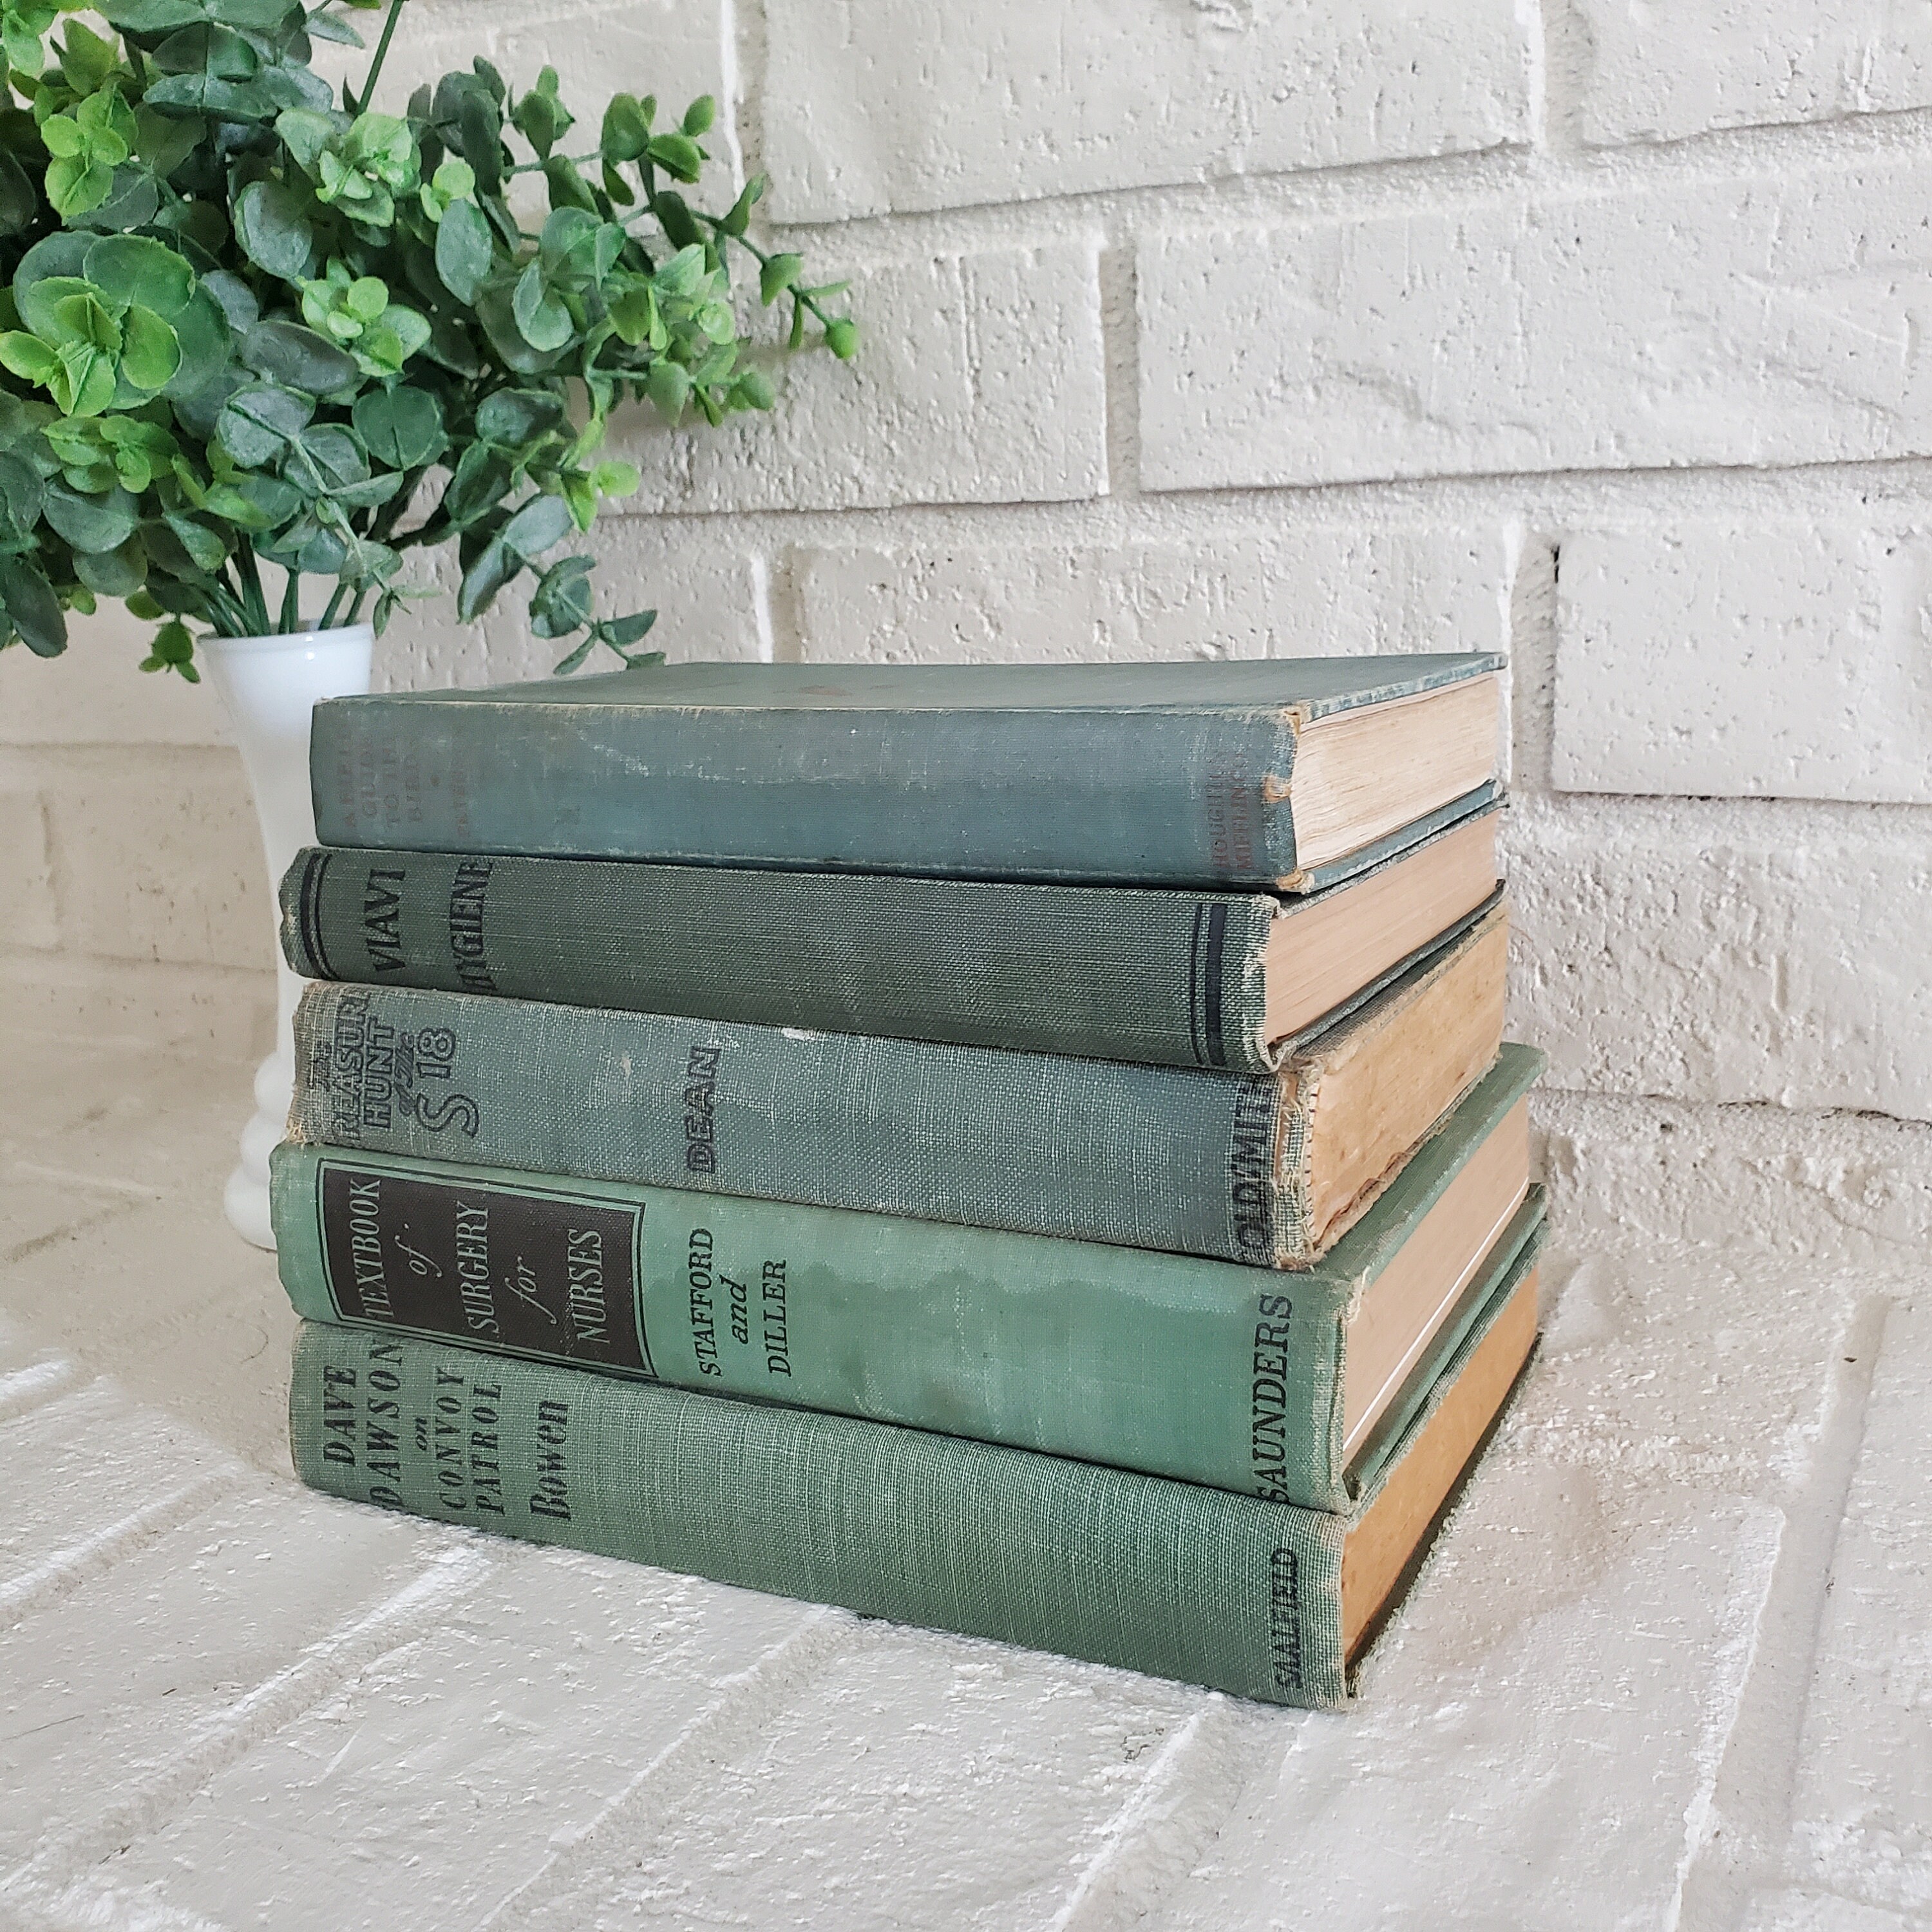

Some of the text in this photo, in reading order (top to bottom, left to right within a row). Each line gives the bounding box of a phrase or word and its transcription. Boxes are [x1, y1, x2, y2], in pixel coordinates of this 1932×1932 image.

[364, 869, 406, 972] VIAVI
[332, 993, 372, 1142] REASUR
[363, 1015, 395, 1129] HUNT
[415, 1028, 456, 1080] 18
[686, 1045, 721, 1174] DEAN
[349, 1179, 394, 1320] TEXTBOOK
[456, 1200, 500, 1334] SURGERY
[504, 1255, 558, 1325] for
[567, 1227, 611, 1345] NURSES
[689, 1227, 723, 1378] STAFFORD
[718, 1273, 749, 1345] and
[759, 1258, 793, 1379] DILLER
[323, 1365, 357, 1466] DAVE
[366, 1339, 404, 1508] DAWSON
[415, 1417, 429, 1451] on
[435, 1365, 466, 1509] CONVOY
[470, 1383, 506, 1516] PATROL
[1252, 1293, 1293, 1504] SAUNDERS
[529, 1400, 572, 1520] Bowen
